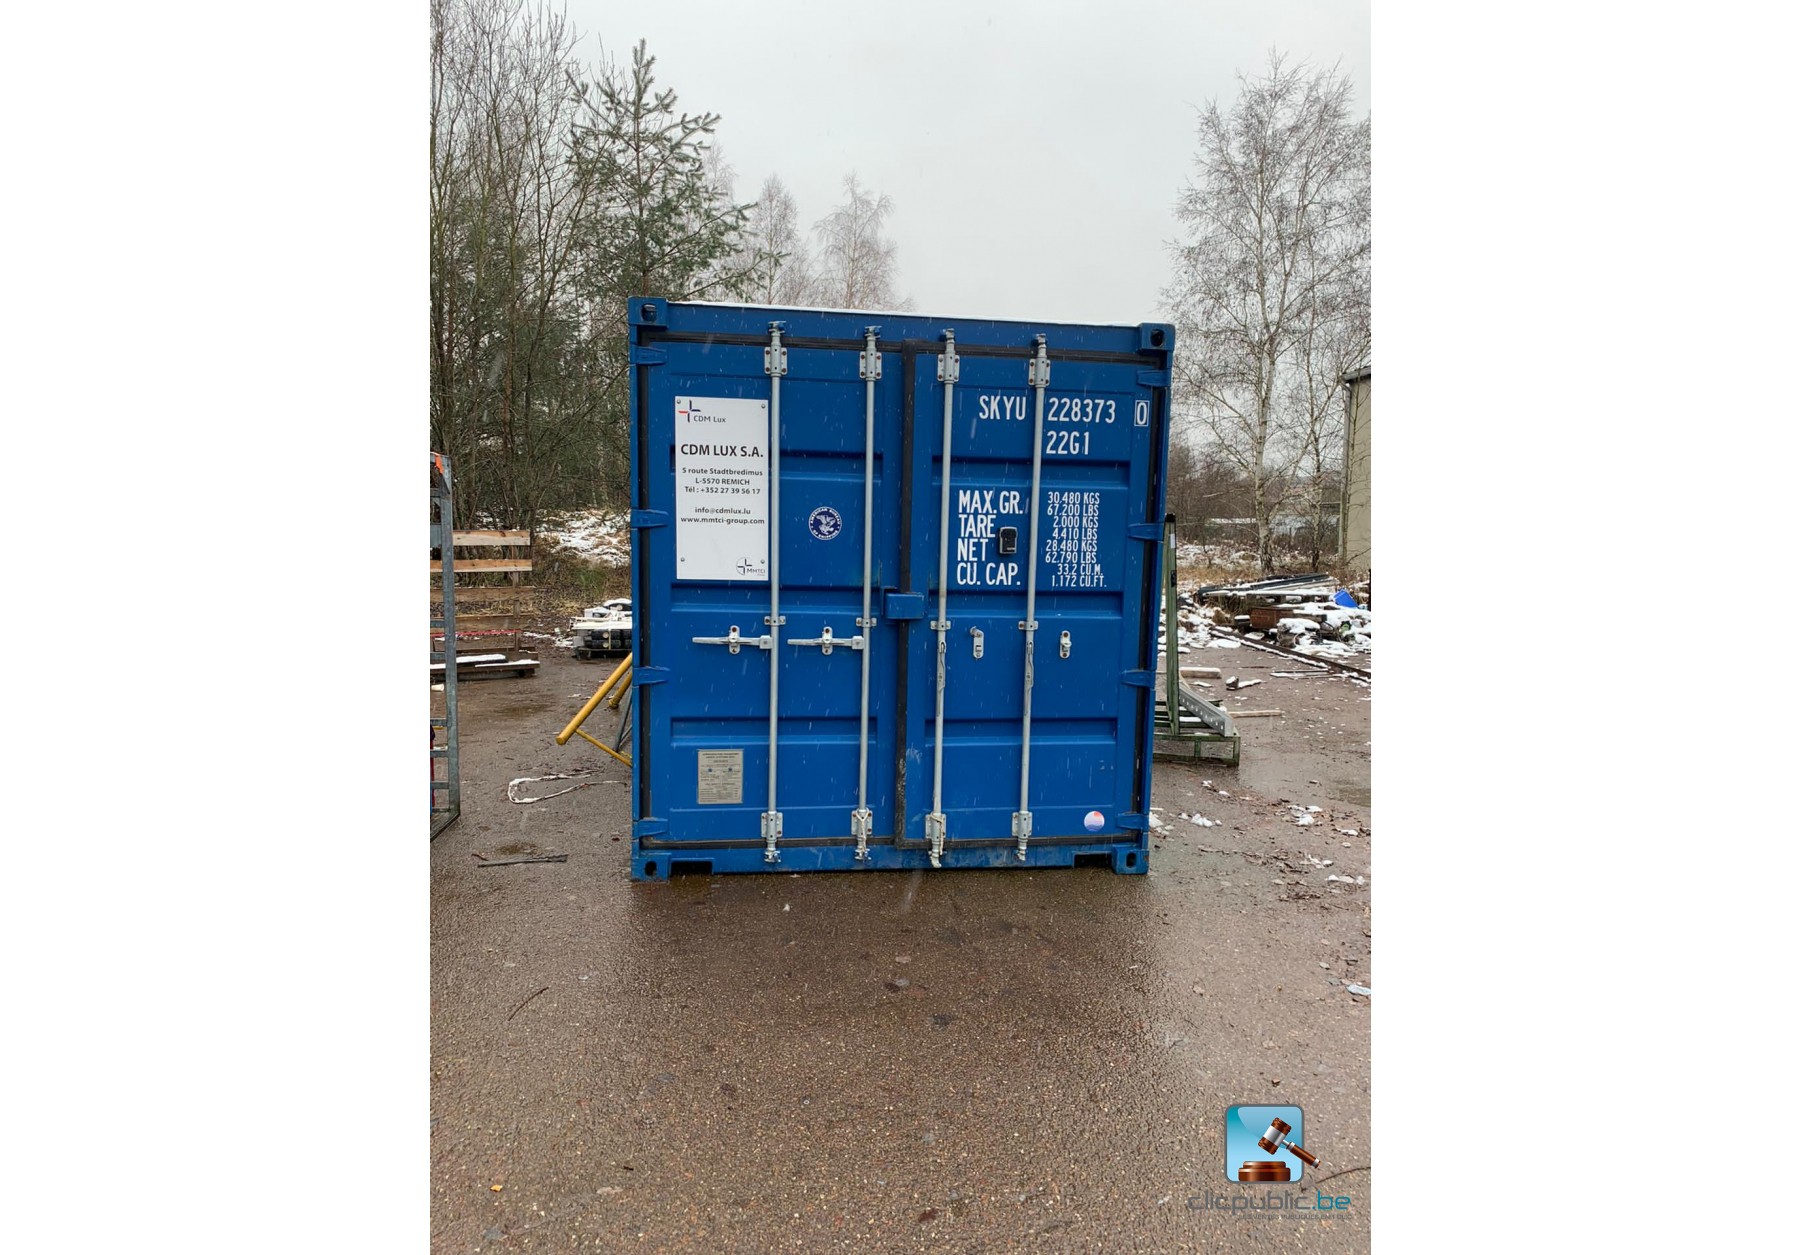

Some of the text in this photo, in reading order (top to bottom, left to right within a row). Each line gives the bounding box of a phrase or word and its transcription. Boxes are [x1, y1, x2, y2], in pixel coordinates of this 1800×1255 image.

[979, 395, 1026, 420] SKYU
[1047, 397, 1116, 423] 228373
[693, 415, 726, 423] CDM Lux
[1046, 431, 1090, 455] 22G1
[680, 444, 764, 458] CDM LUX S.A.
[688, 467, 708, 475] route
[709, 468, 763, 476] Stadtbredimus
[695, 477, 750, 486] L-5570 REMICH
[1083, 492, 1100, 505] KGS
[695, 507, 751, 515] info@cdmlux.lu
[1082, 504, 1099, 516] LBS
[680, 516, 765, 525] www.mmtci-group.com
[958, 514, 997, 538] TARE
[1082, 516, 1099, 528] KGS
[1081, 528, 1098, 540] LBS
[957, 538, 989, 561] NET
[1081, 540, 1098, 552] KGS
[1080, 551, 1097, 563] LBS
[956, 562, 1021, 586] CU. CAP.
